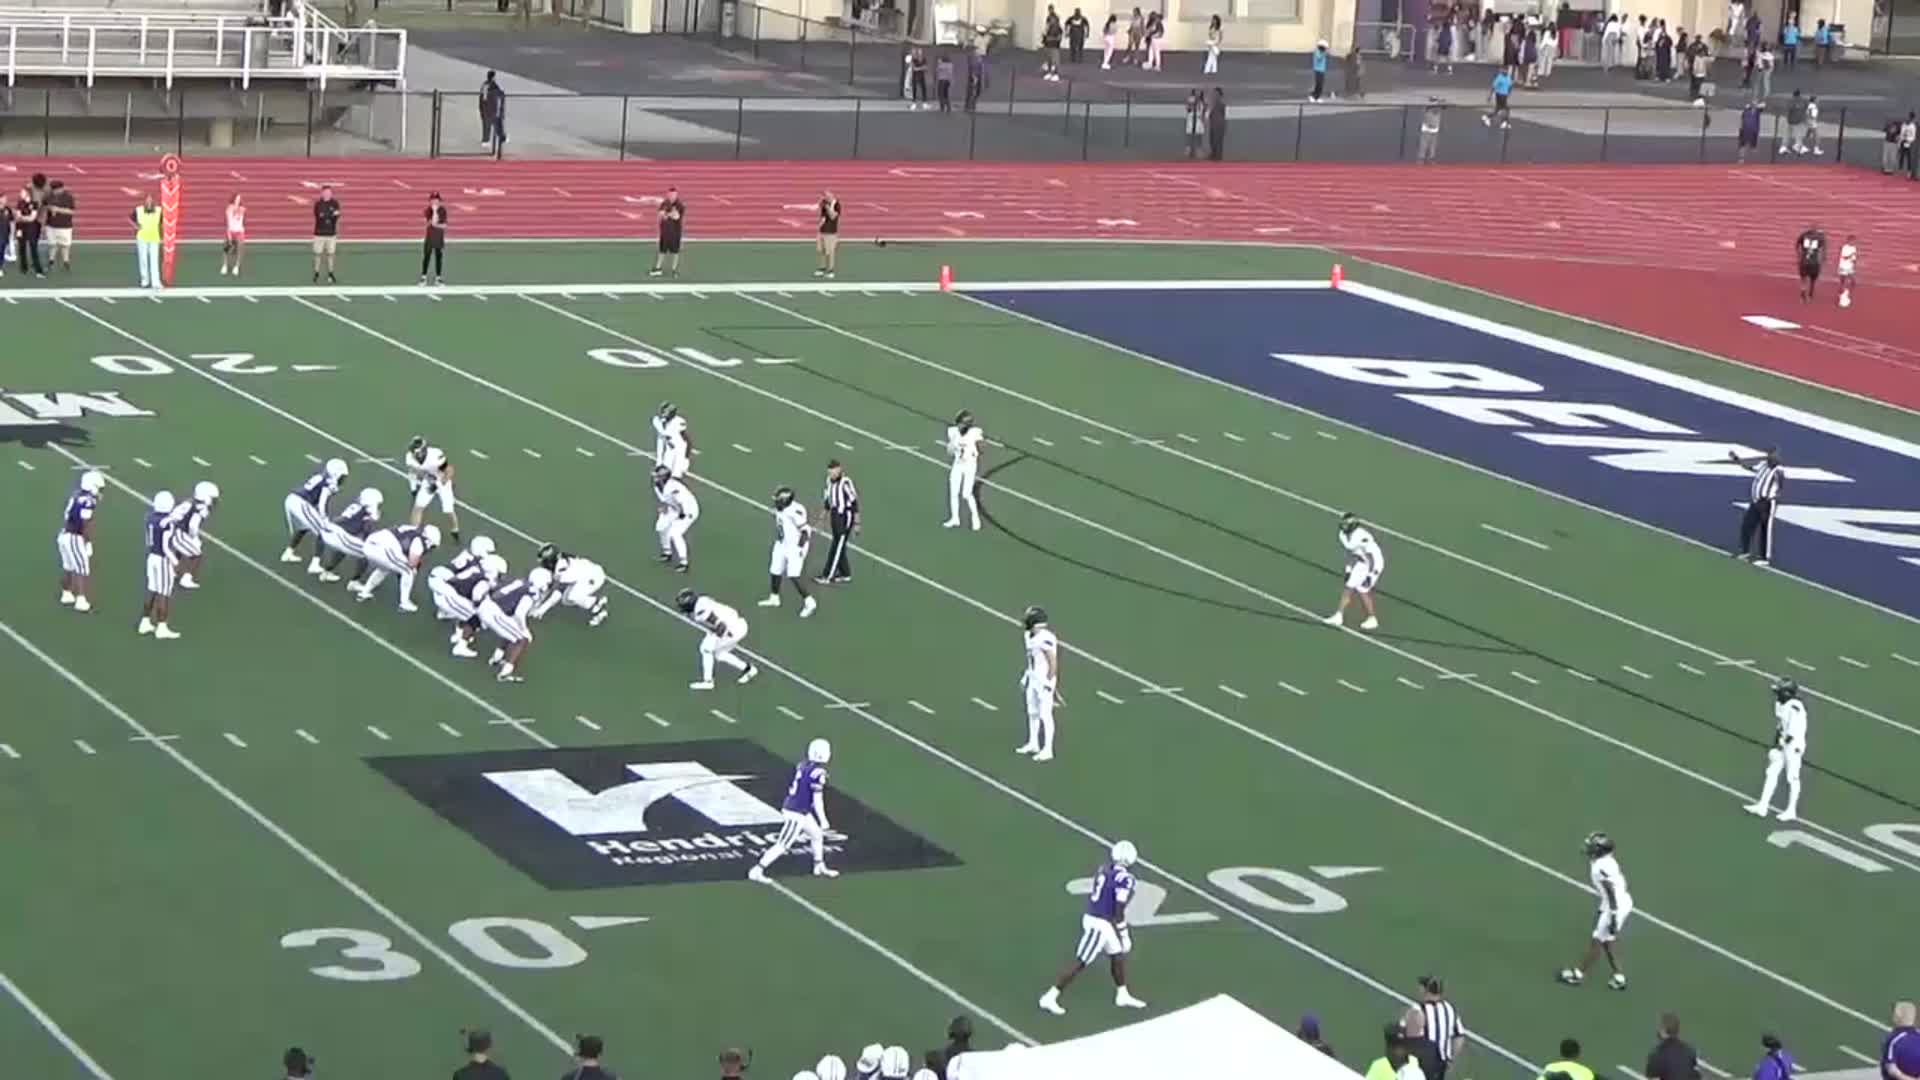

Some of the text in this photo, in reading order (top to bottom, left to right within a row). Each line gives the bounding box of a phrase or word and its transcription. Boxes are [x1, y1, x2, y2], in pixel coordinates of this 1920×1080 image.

[1269, 353, 1857, 483] BEN
[1065, 867, 1348, 926] 20
[281, 917, 588, 981] 30
